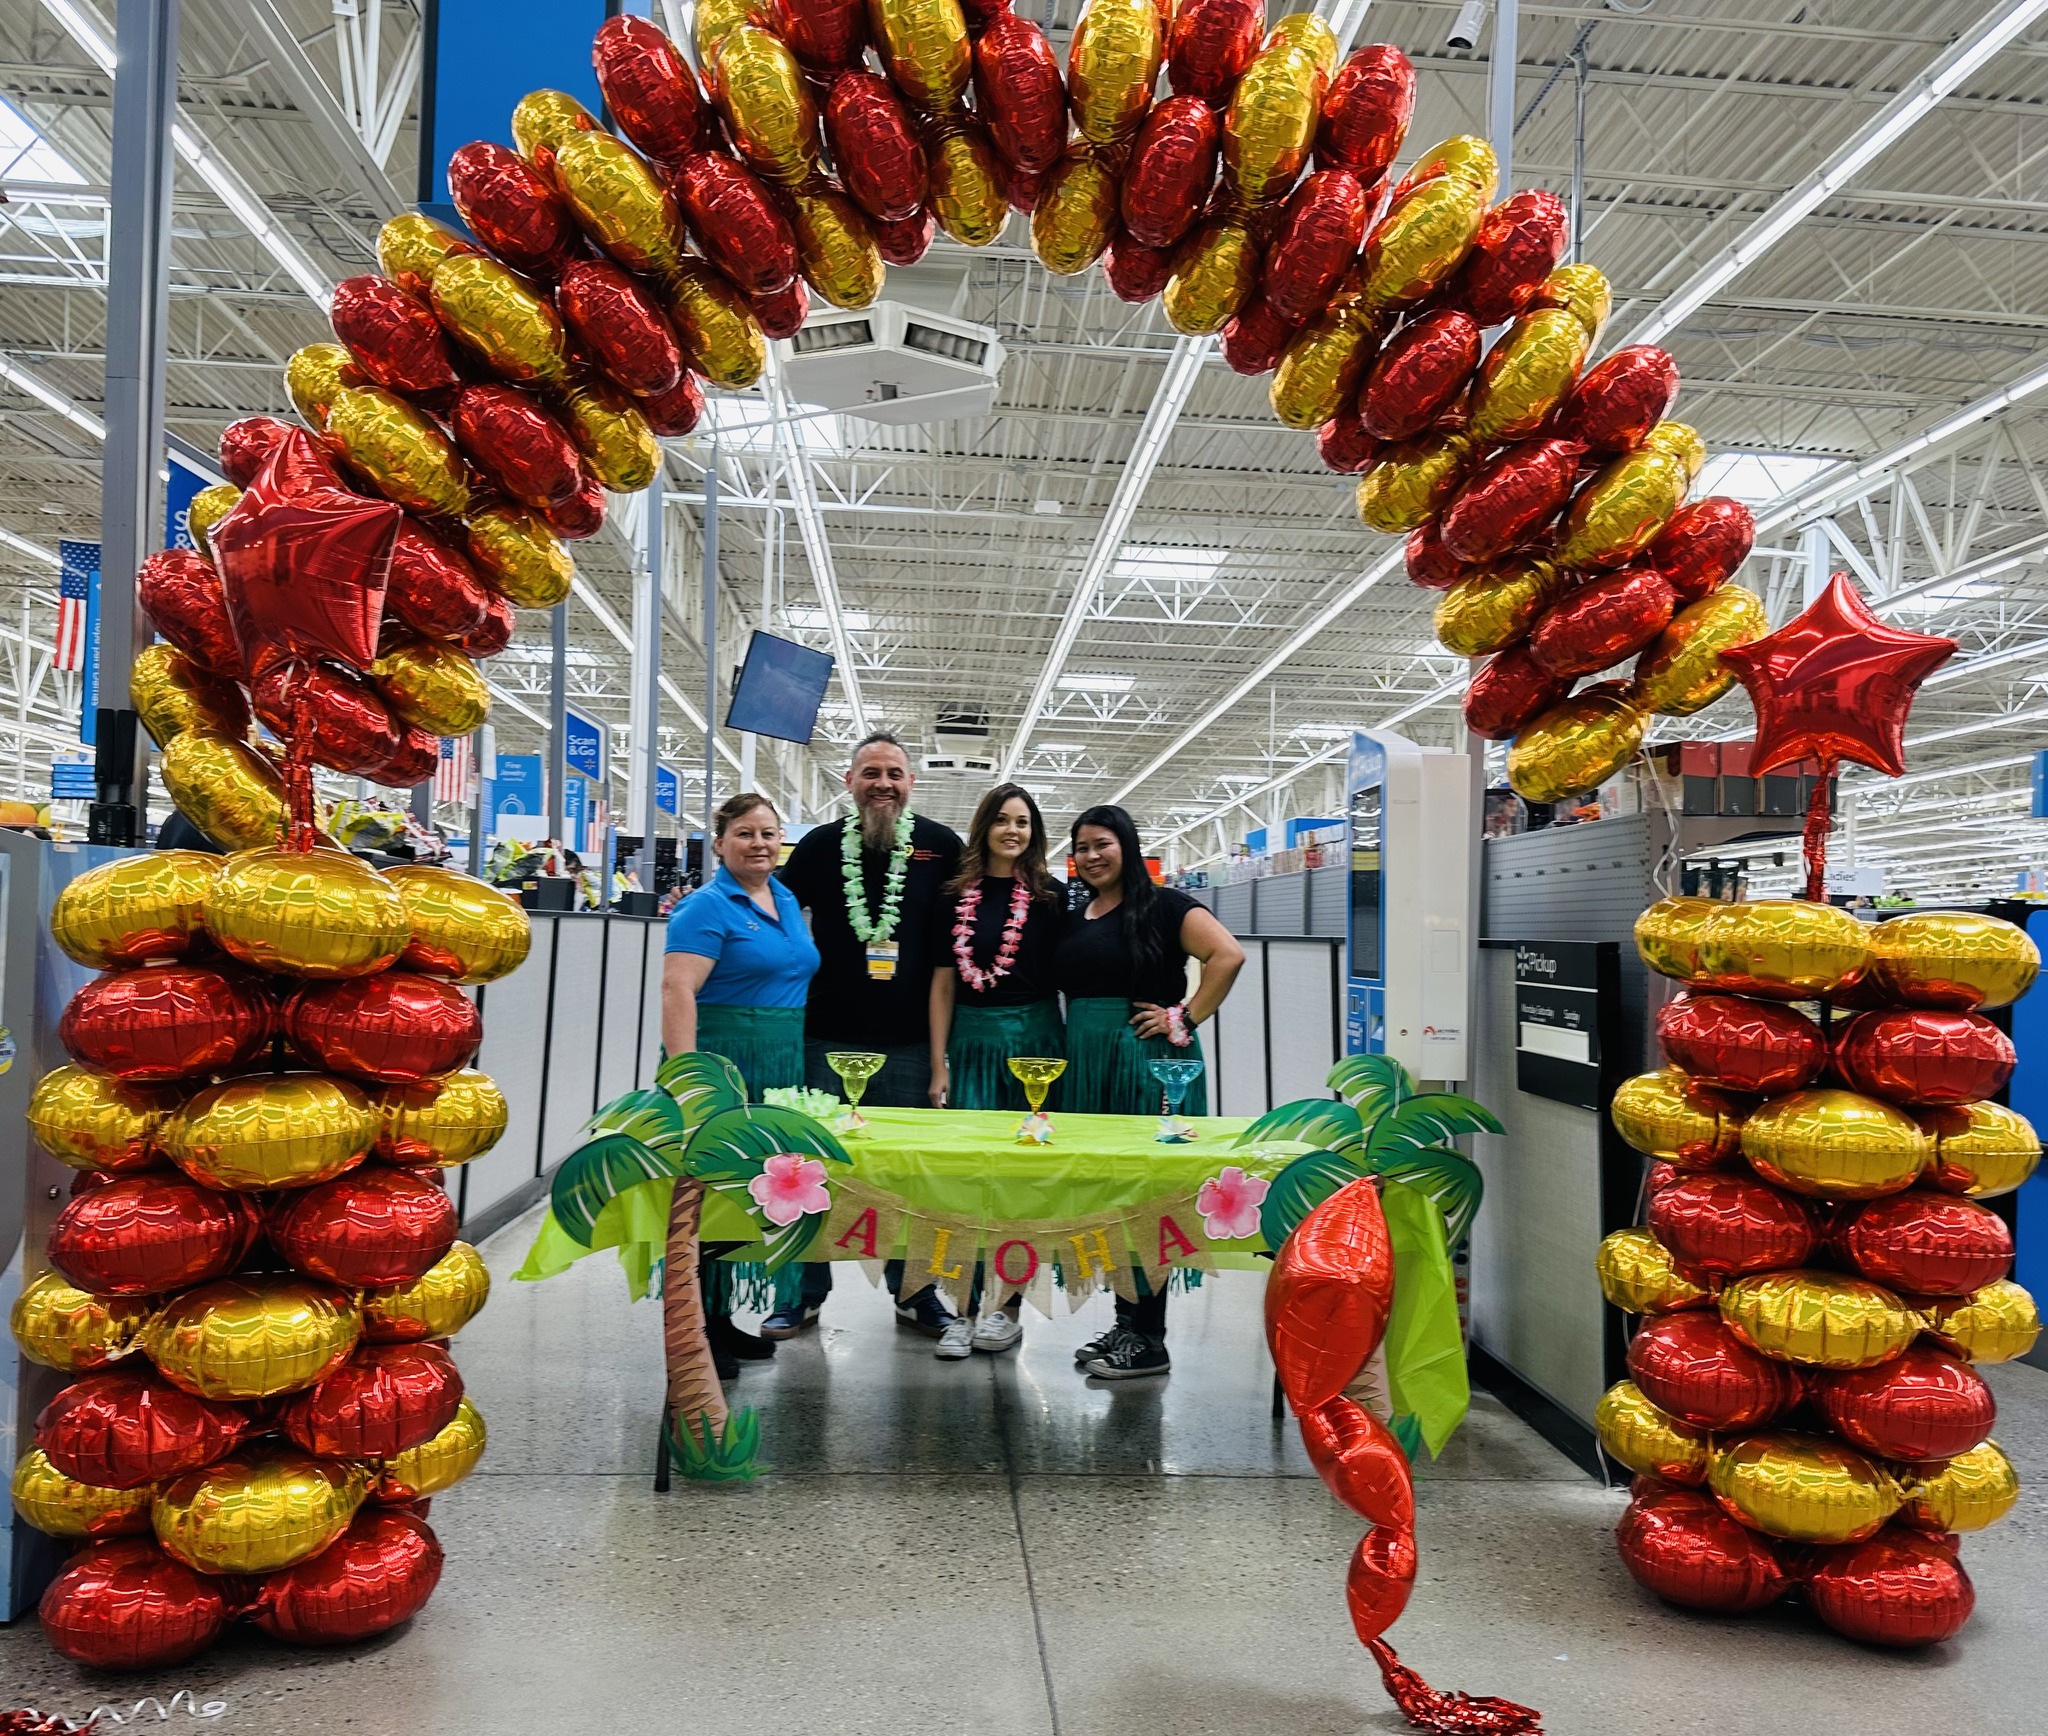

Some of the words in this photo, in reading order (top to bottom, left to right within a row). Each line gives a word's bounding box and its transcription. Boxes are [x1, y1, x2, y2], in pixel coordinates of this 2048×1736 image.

[568, 735, 597, 746] Scan
[568, 746, 596, 756] &Go
[569, 797, 580, 817] Men
[1528, 952, 1557, 979] Pickup
[834, 1206, 1199, 1285] ALOHA
